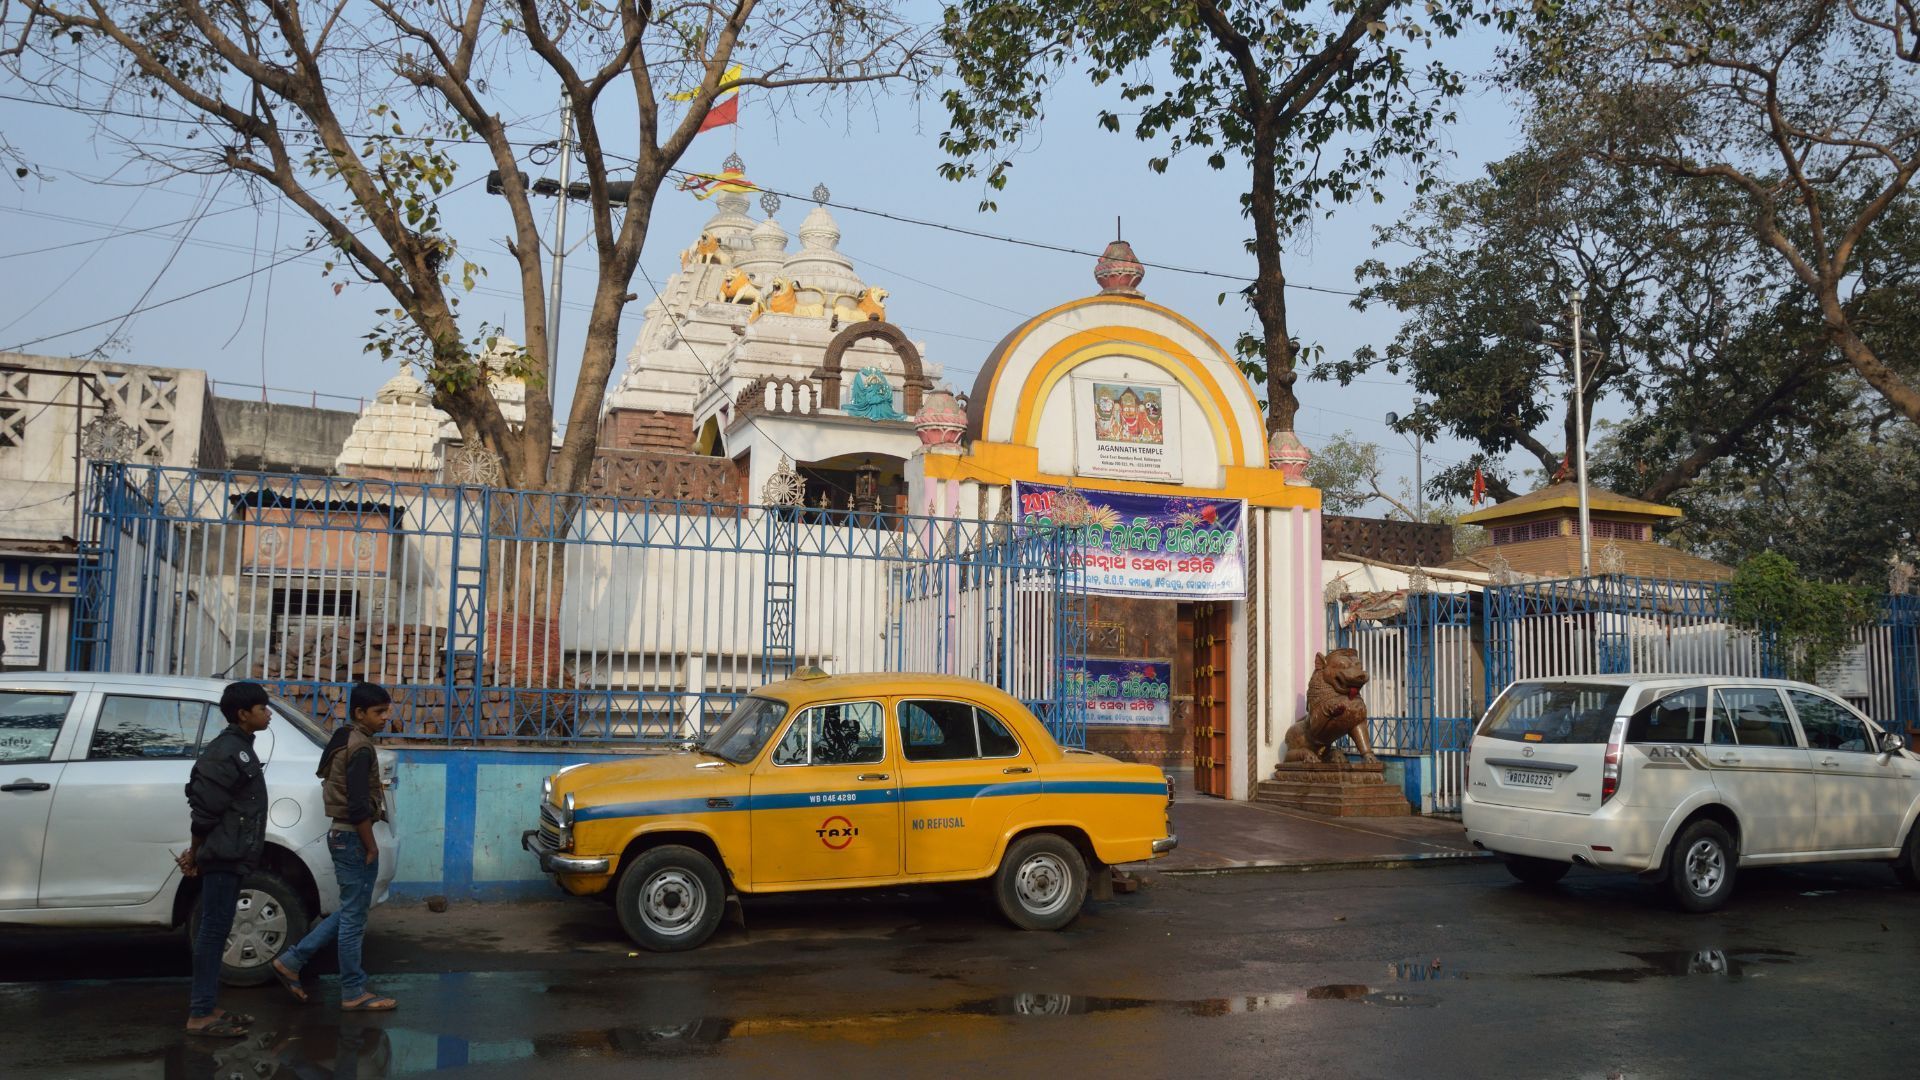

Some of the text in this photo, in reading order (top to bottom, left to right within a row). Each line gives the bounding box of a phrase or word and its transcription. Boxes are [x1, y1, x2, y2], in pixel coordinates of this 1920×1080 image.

[1097, 444, 1164, 456] JAGANNATH TEMPLE
[1649, 746, 1698, 758] ARIA
[809, 794, 821, 803] WB
[822, 794, 836, 803] 04E
[912, 816, 965, 830] NO REFUSAL
[815, 827, 859, 838] TAXI
